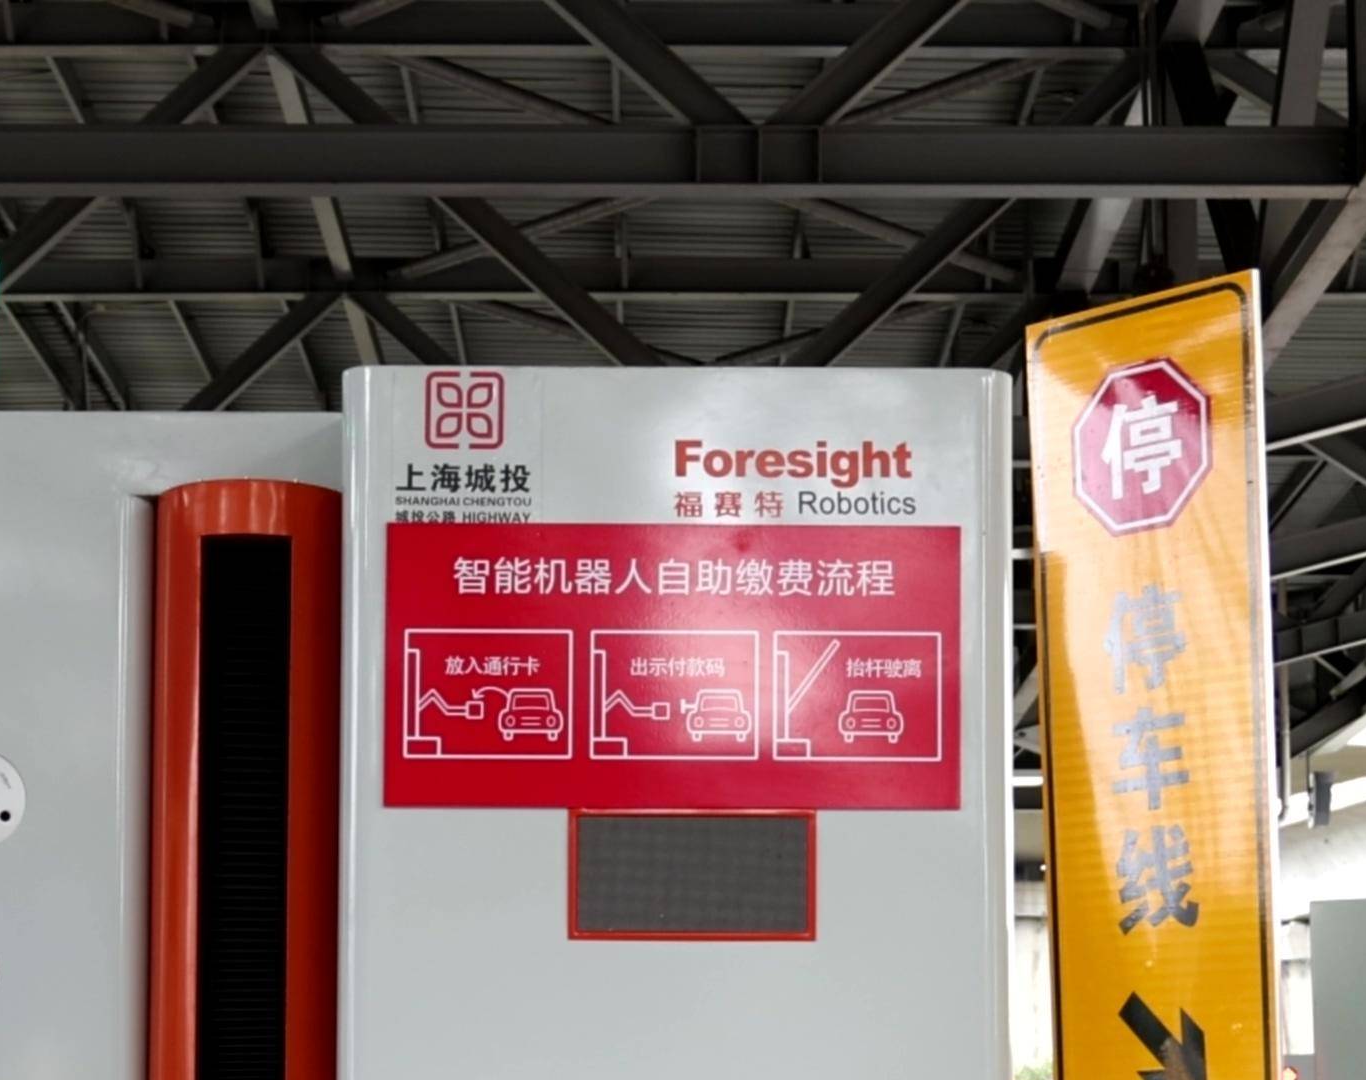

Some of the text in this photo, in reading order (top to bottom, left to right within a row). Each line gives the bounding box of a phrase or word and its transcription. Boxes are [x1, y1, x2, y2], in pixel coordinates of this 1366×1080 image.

[1101, 395, 1182, 500] 停
[675, 440, 912, 488] Foresight
[395, 463, 531, 493] 上海城投
[395, 496, 532, 507] SHANGHAI CHENGTOU
[673, 491, 916, 518] 福赛特 Robotics
[395, 509, 531, 524] 城投公路 HIGHWAY
[452, 556, 896, 598] 智能机器人自助缴费流程
[445, 655, 541, 677] 放入通行卡
[630, 656, 726, 677] 出示付款码
[846, 657, 922, 679] 抬杆驶离
[1102, 583, 1200, 936] 停车线
